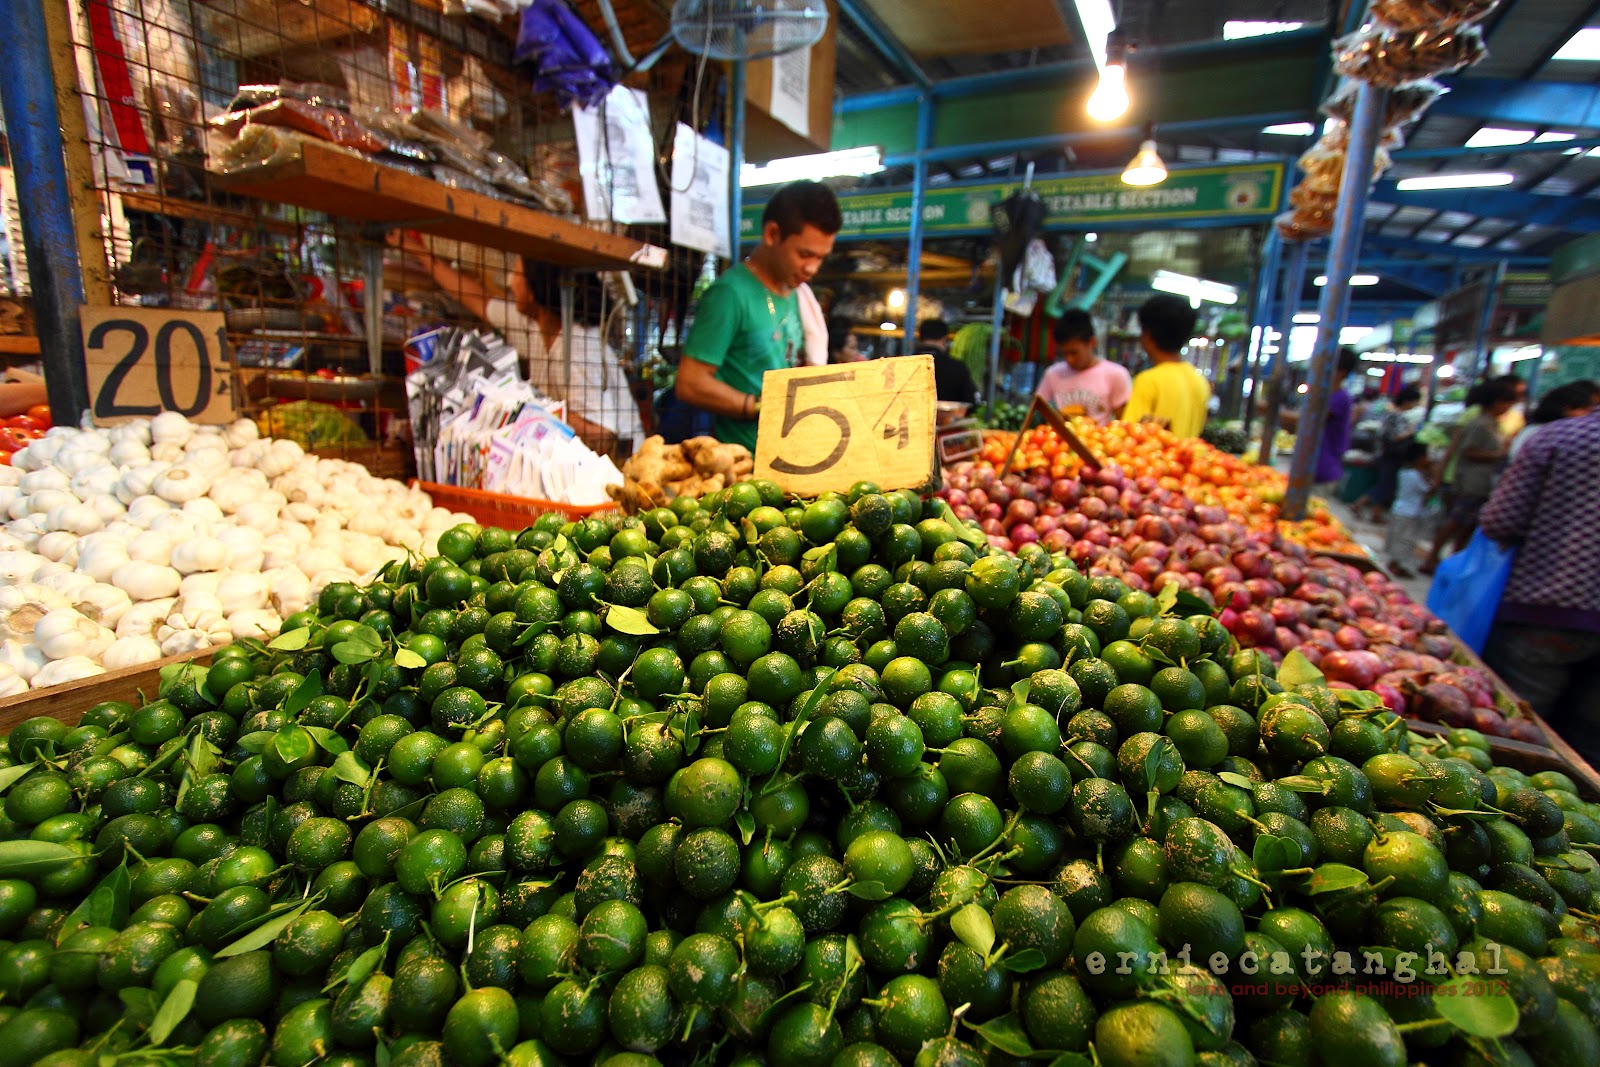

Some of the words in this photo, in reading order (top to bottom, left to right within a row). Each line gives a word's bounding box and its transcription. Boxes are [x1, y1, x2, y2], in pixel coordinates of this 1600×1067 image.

[842, 208, 882, 225] TABLE
[885, 204, 945, 224] SECON
[1048, 192, 1115, 211] ETABLE
[1118, 187, 1199, 209] SECTION
[88, 319, 212, 418] 20
[769, 370, 856, 475] 5
